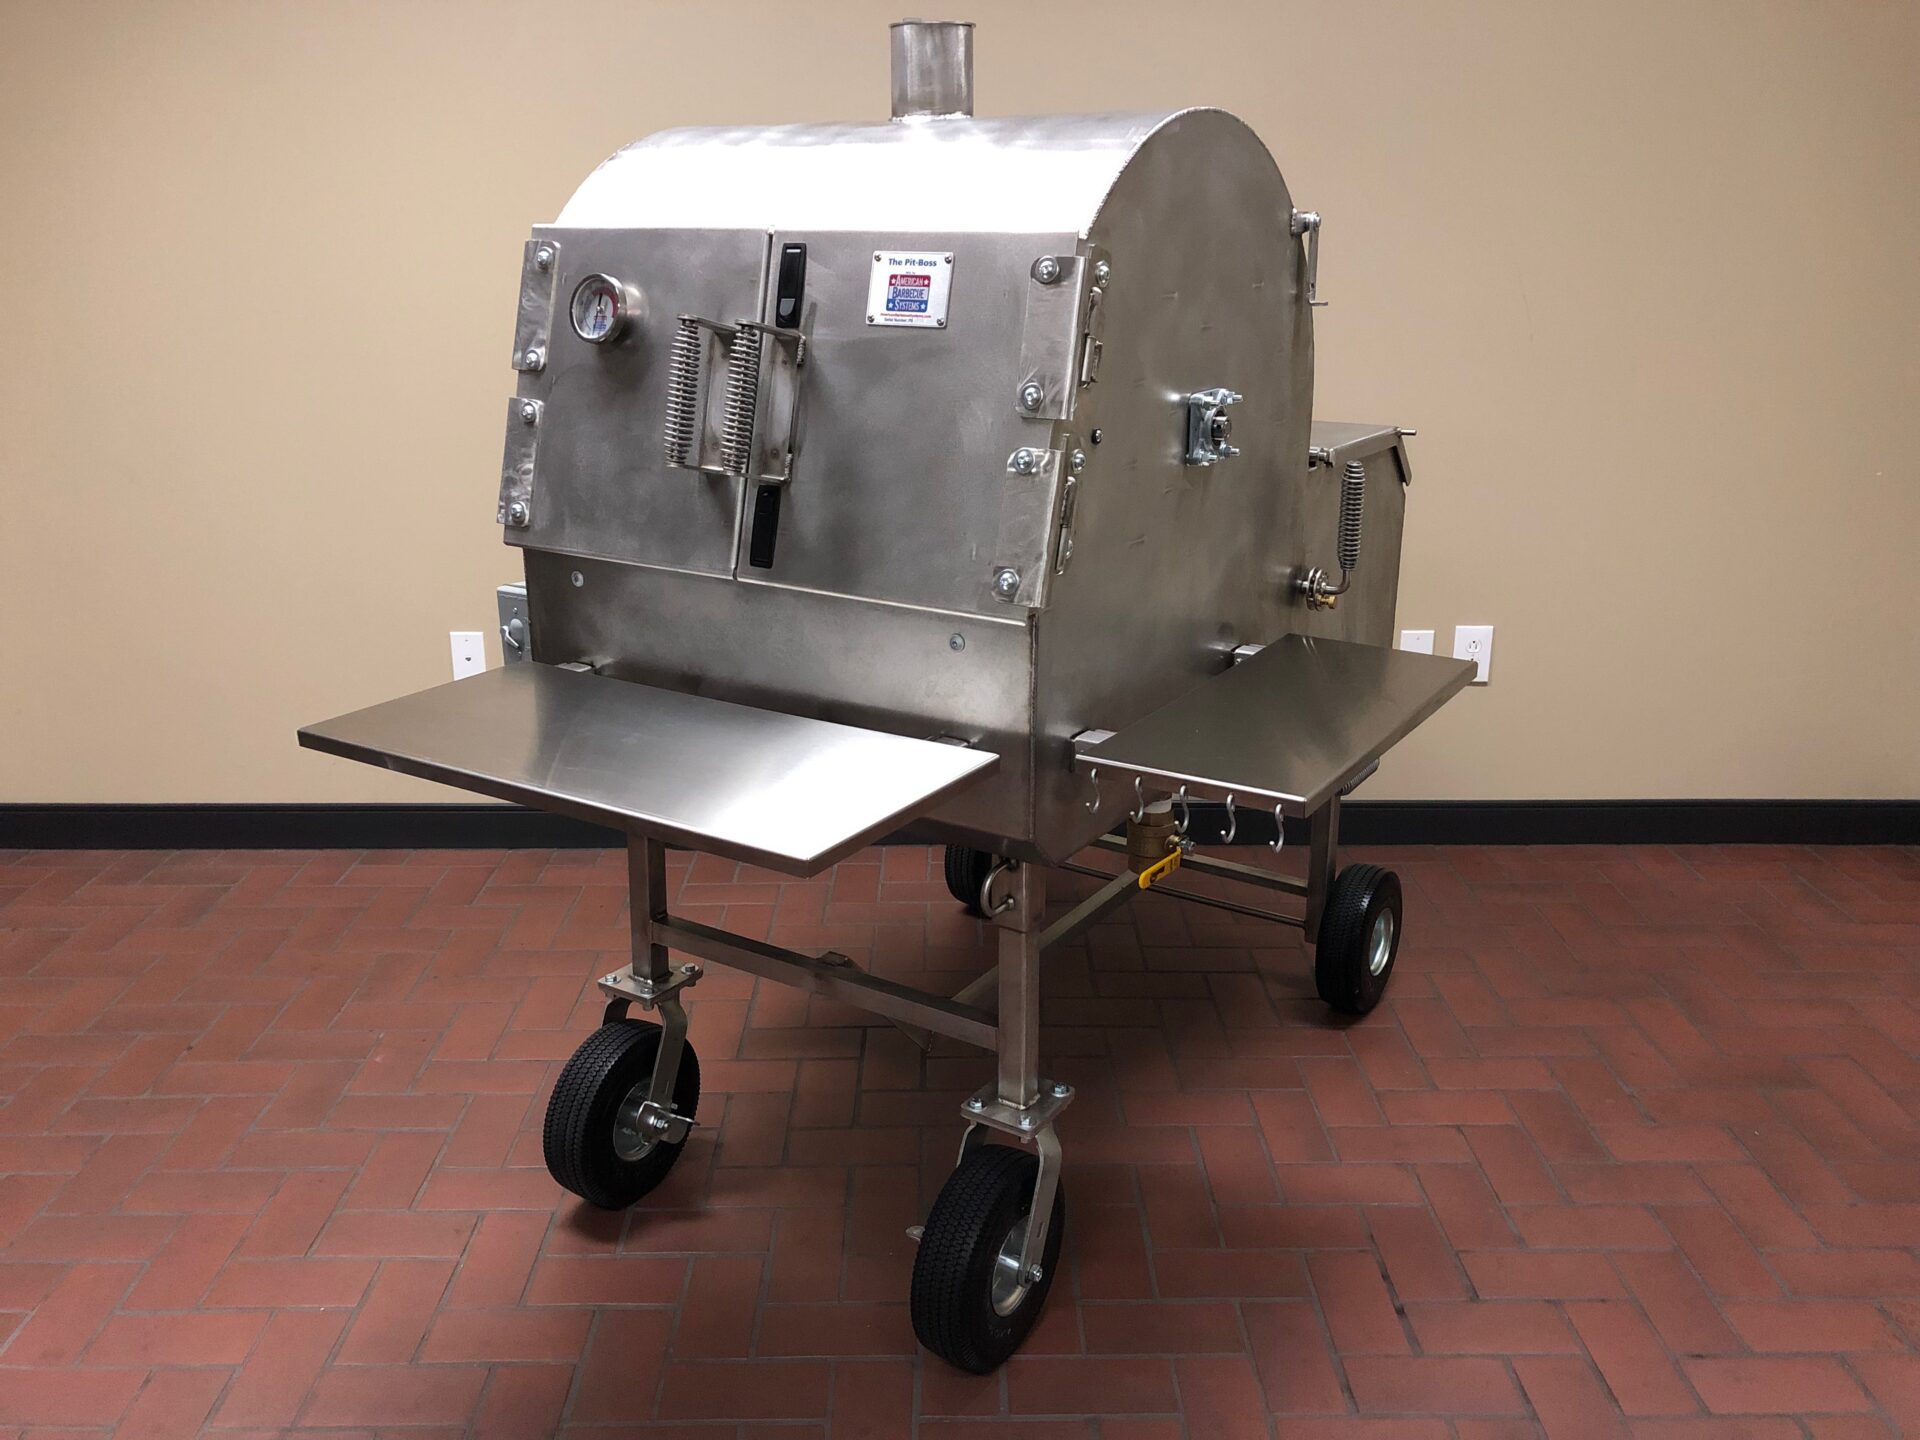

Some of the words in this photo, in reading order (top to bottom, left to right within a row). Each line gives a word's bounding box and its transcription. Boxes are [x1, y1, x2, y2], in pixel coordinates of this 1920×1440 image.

[888, 258, 903, 266] The
[904, 258, 937, 267] Pit-Boss
[896, 275, 924, 286] AMERICAN
[892, 286, 925, 299] BARBECUE
[894, 299, 920, 311] SYSTEMS
